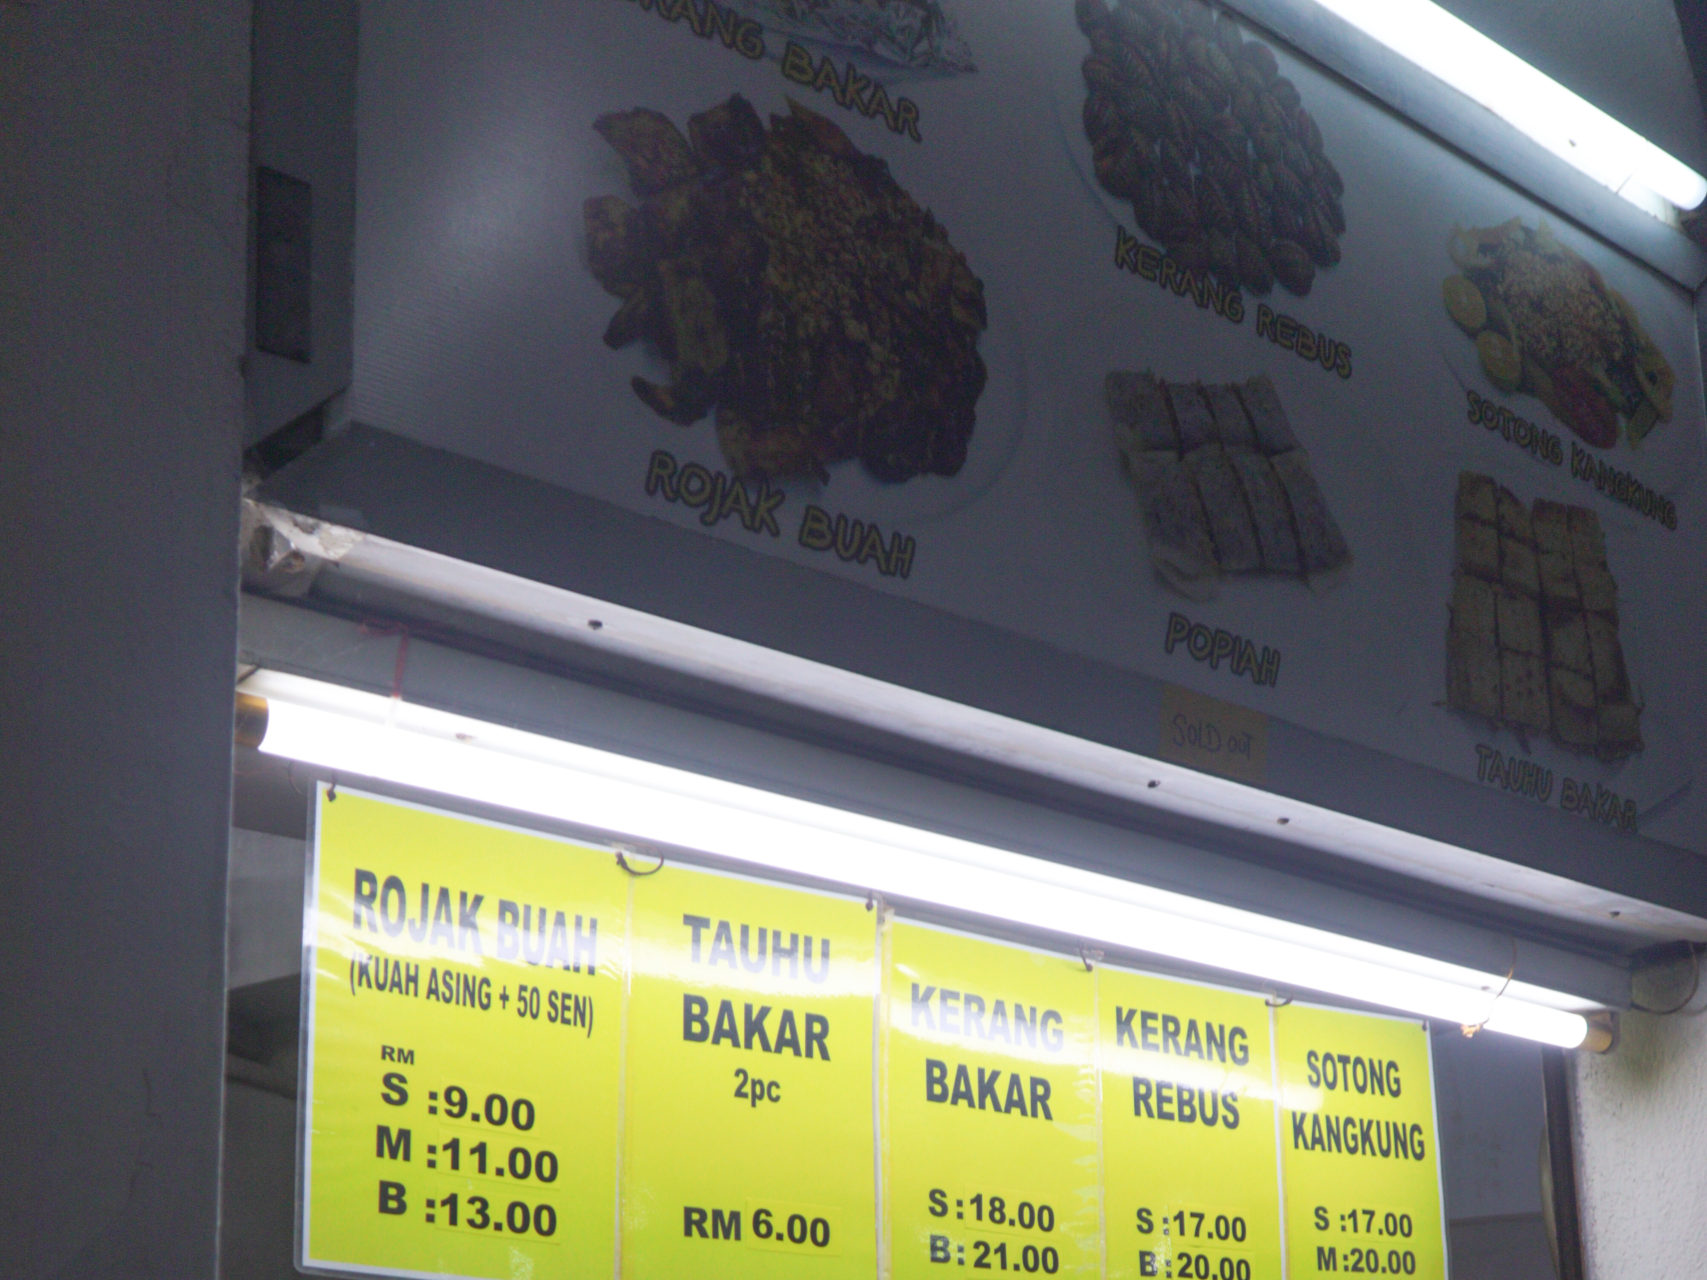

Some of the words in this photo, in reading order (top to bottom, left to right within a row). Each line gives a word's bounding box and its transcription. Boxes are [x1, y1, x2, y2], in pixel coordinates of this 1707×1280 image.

[781, 39, 922, 144] BAKAR
[1115, 224, 1245, 324] KERANG
[1256, 303, 1352, 379] REBUS
[1466, 389, 1563, 466] SOTONG
[1570, 441, 1678, 530] KANGKUNG
[645, 450, 785, 538] ROJAK
[799, 504, 916, 580] BUAH
[1165, 612, 1281, 687] POPIAH
[1476, 743, 1553, 802] TAUHU
[1560, 777, 1638, 834] BAKAR
[353, 868, 484, 955] ROJAK
[496, 899, 597, 976] BUAH
[683, 913, 830, 985] TAUHU
[350, 952, 419, 998] (KUAH
[426, 967, 492, 1011] ASING
[499, 985, 510, 1010] +
[517, 984, 541, 1020] 50
[547, 990, 594, 1039] SEN)
[683, 993, 831, 1062] BAKAR
[911, 982, 1064, 1052] KERANG
[381, 1045, 415, 1065] RM
[1115, 1006, 1249, 1066] KERANG
[381, 1072, 408, 1106] S
[734, 1068, 781, 1108] 2pc
[926, 1058, 1053, 1121] BAKAR
[1132, 1075, 1240, 1130] REBUS
[1307, 1049, 1401, 1098] SOTONG
[376, 1124, 411, 1162] M
[1291, 1110, 1425, 1162] KANGKUNG
[378, 1180, 407, 1215] B
[683, 1206, 742, 1241] RM
[752, 1208, 830, 1248] 6.00
